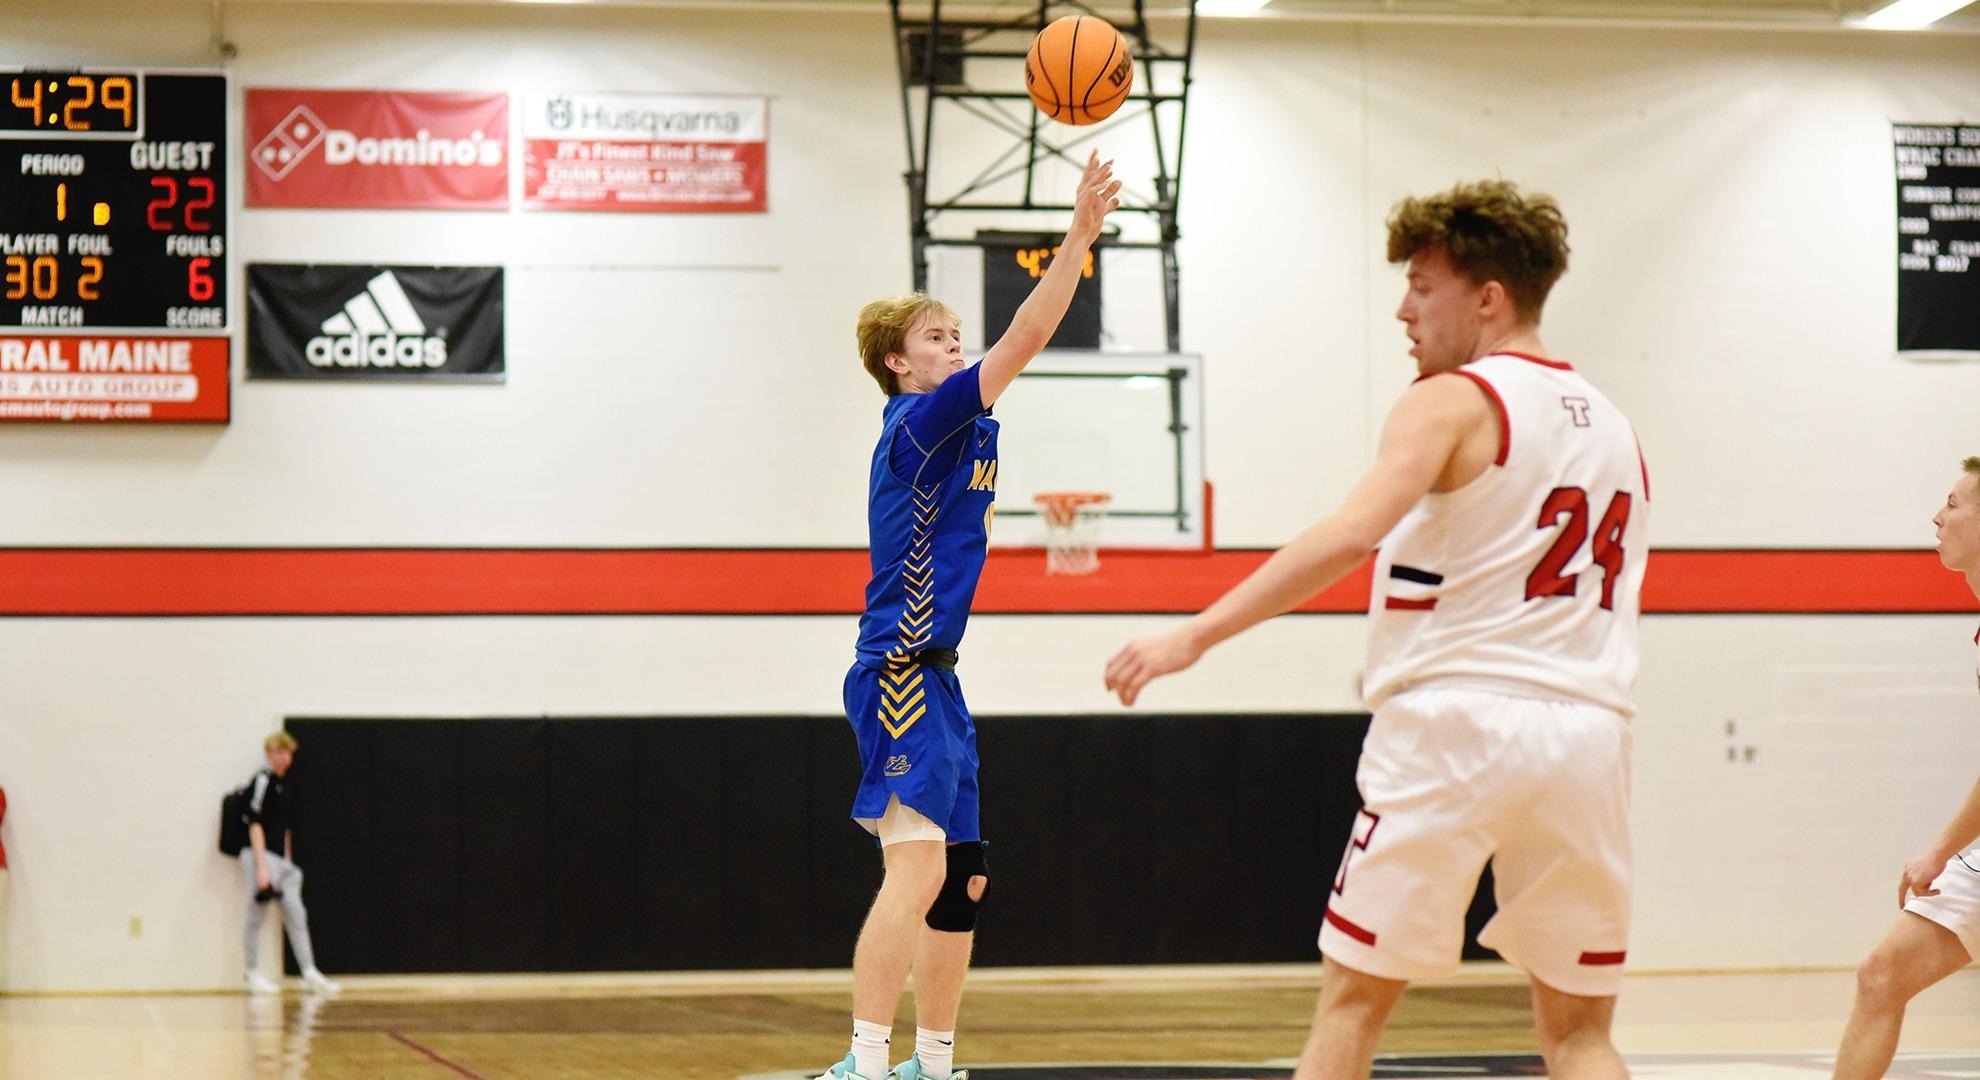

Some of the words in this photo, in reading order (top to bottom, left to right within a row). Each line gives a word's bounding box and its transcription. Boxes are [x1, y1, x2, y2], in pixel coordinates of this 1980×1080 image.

[11, 76, 134, 131] 4:29
[581, 105, 740, 139] Husqvarna
[130, 142, 215, 170] GUEST
[324, 129, 502, 167] Domino's
[21, 154, 85, 176] PERIOD
[57, 183, 67, 221] 1
[147, 177, 216, 231] 22
[68, 234, 113, 256] FOUL
[166, 236, 224, 257] FOULS
[6, 256, 59, 299] 30
[78, 257, 104, 300] 2
[188, 257, 215, 301] 6
[21, 306, 84, 327] MATCH
[166, 307, 224, 328] SCORE
[79, 340, 192, 373] MAINE
[306, 332, 447, 367] adidas
[30, 379, 93, 394] AUTO
[103, 379, 184, 394] GROUP
[1562, 396, 1590, 427] T
[1525, 486, 1632, 612] 24
